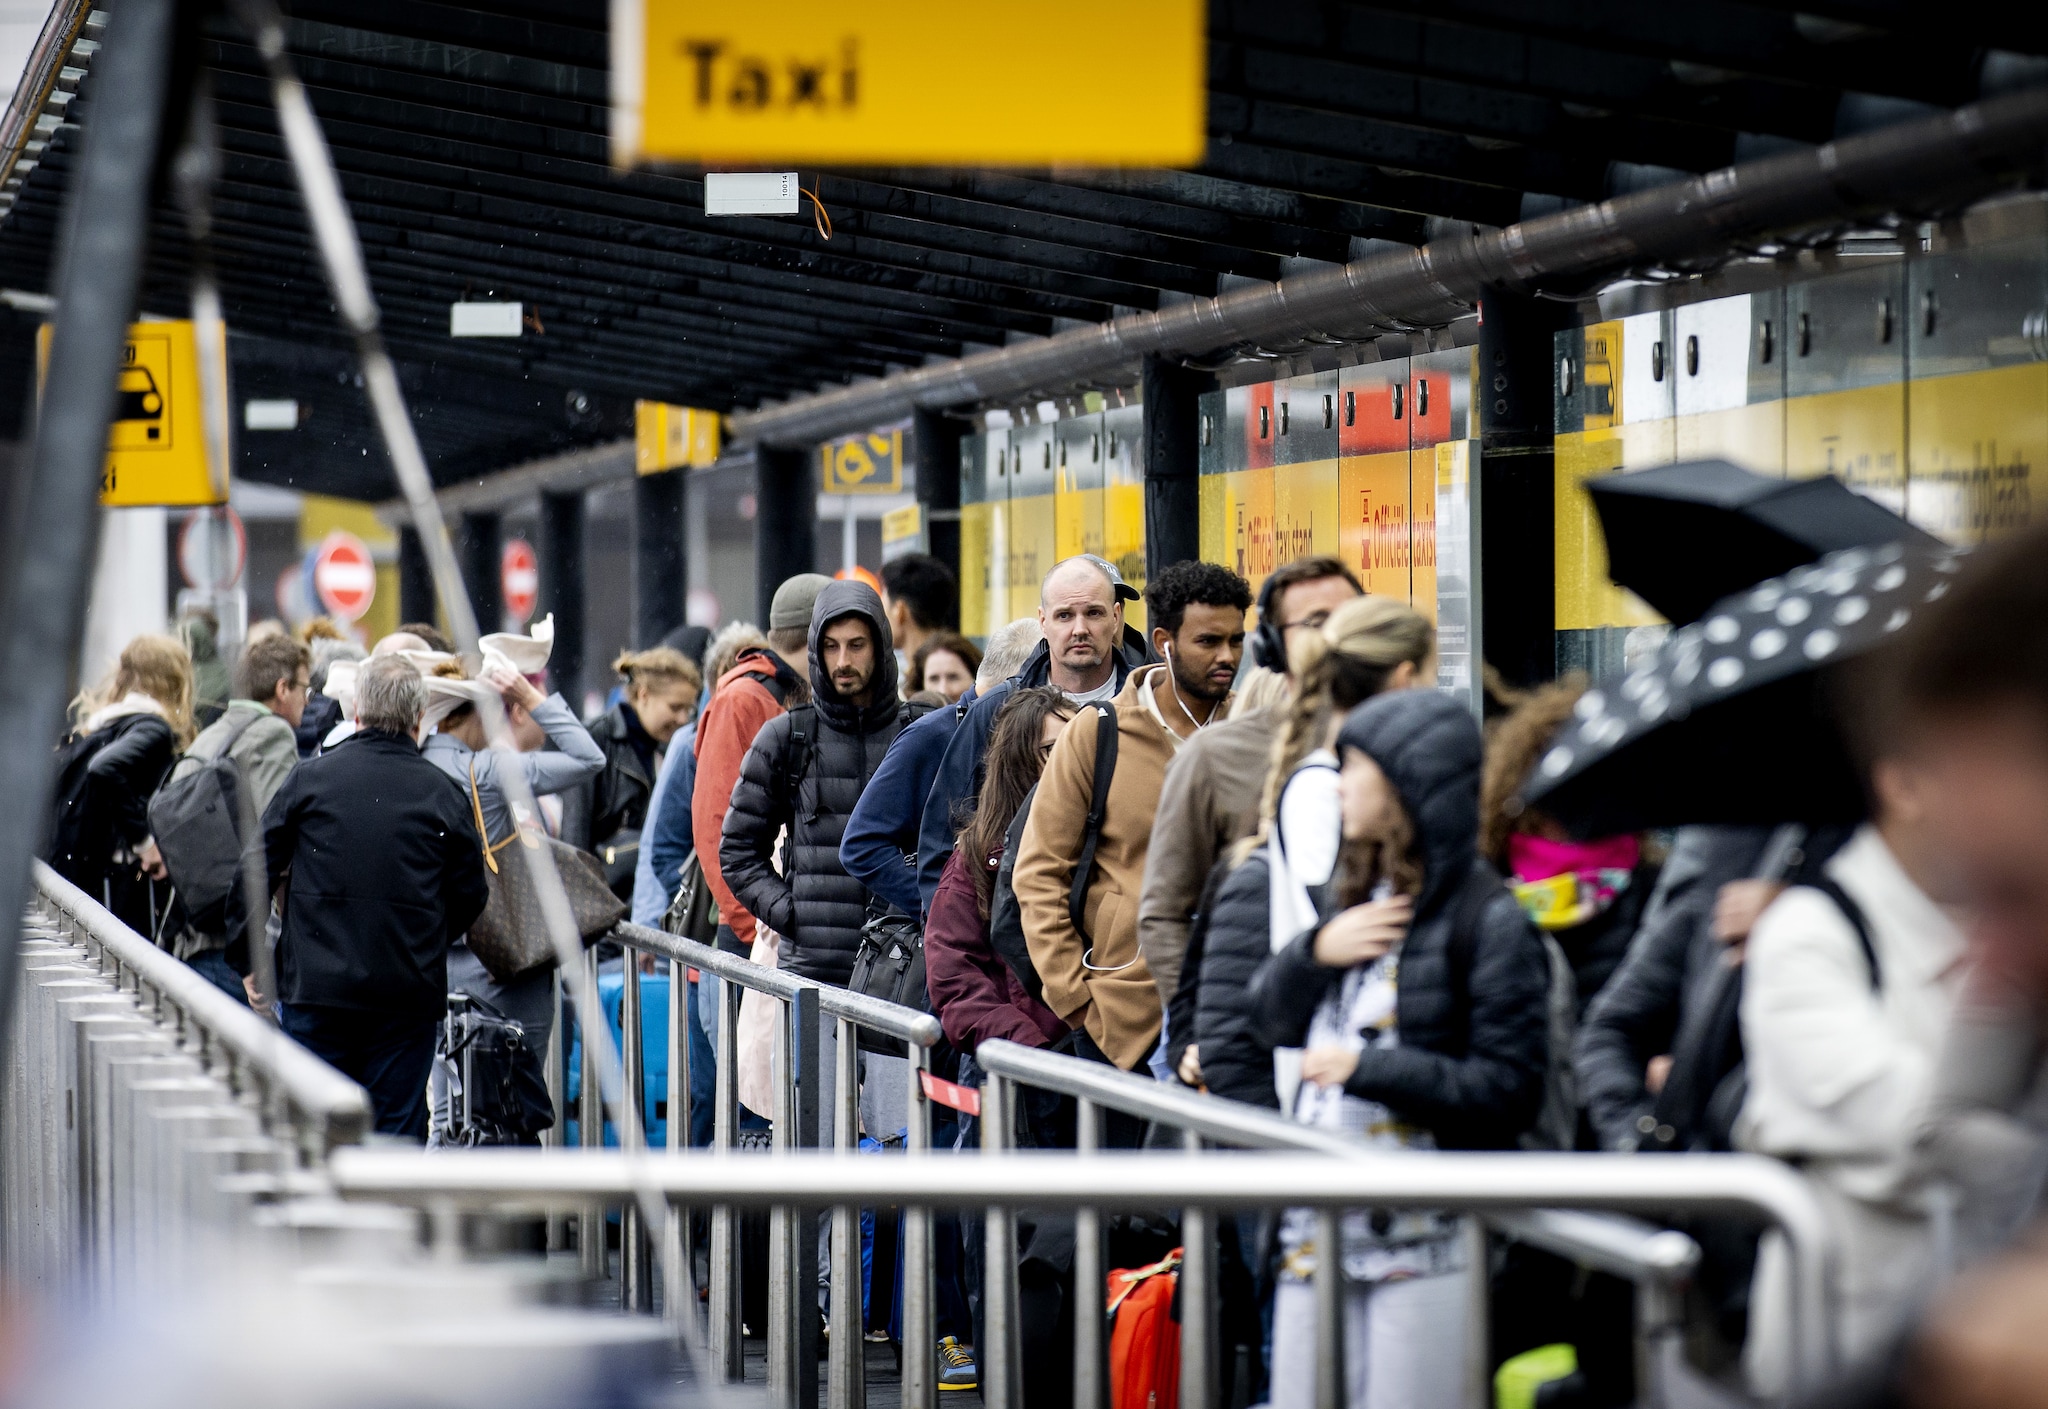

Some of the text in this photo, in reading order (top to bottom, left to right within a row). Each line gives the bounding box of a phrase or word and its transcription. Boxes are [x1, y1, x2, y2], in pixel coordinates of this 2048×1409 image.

[681, 35, 858, 112] Taxi
[1247, 509, 1313, 576] Official taxi stand
[1374, 503, 1409, 569] Officiële
